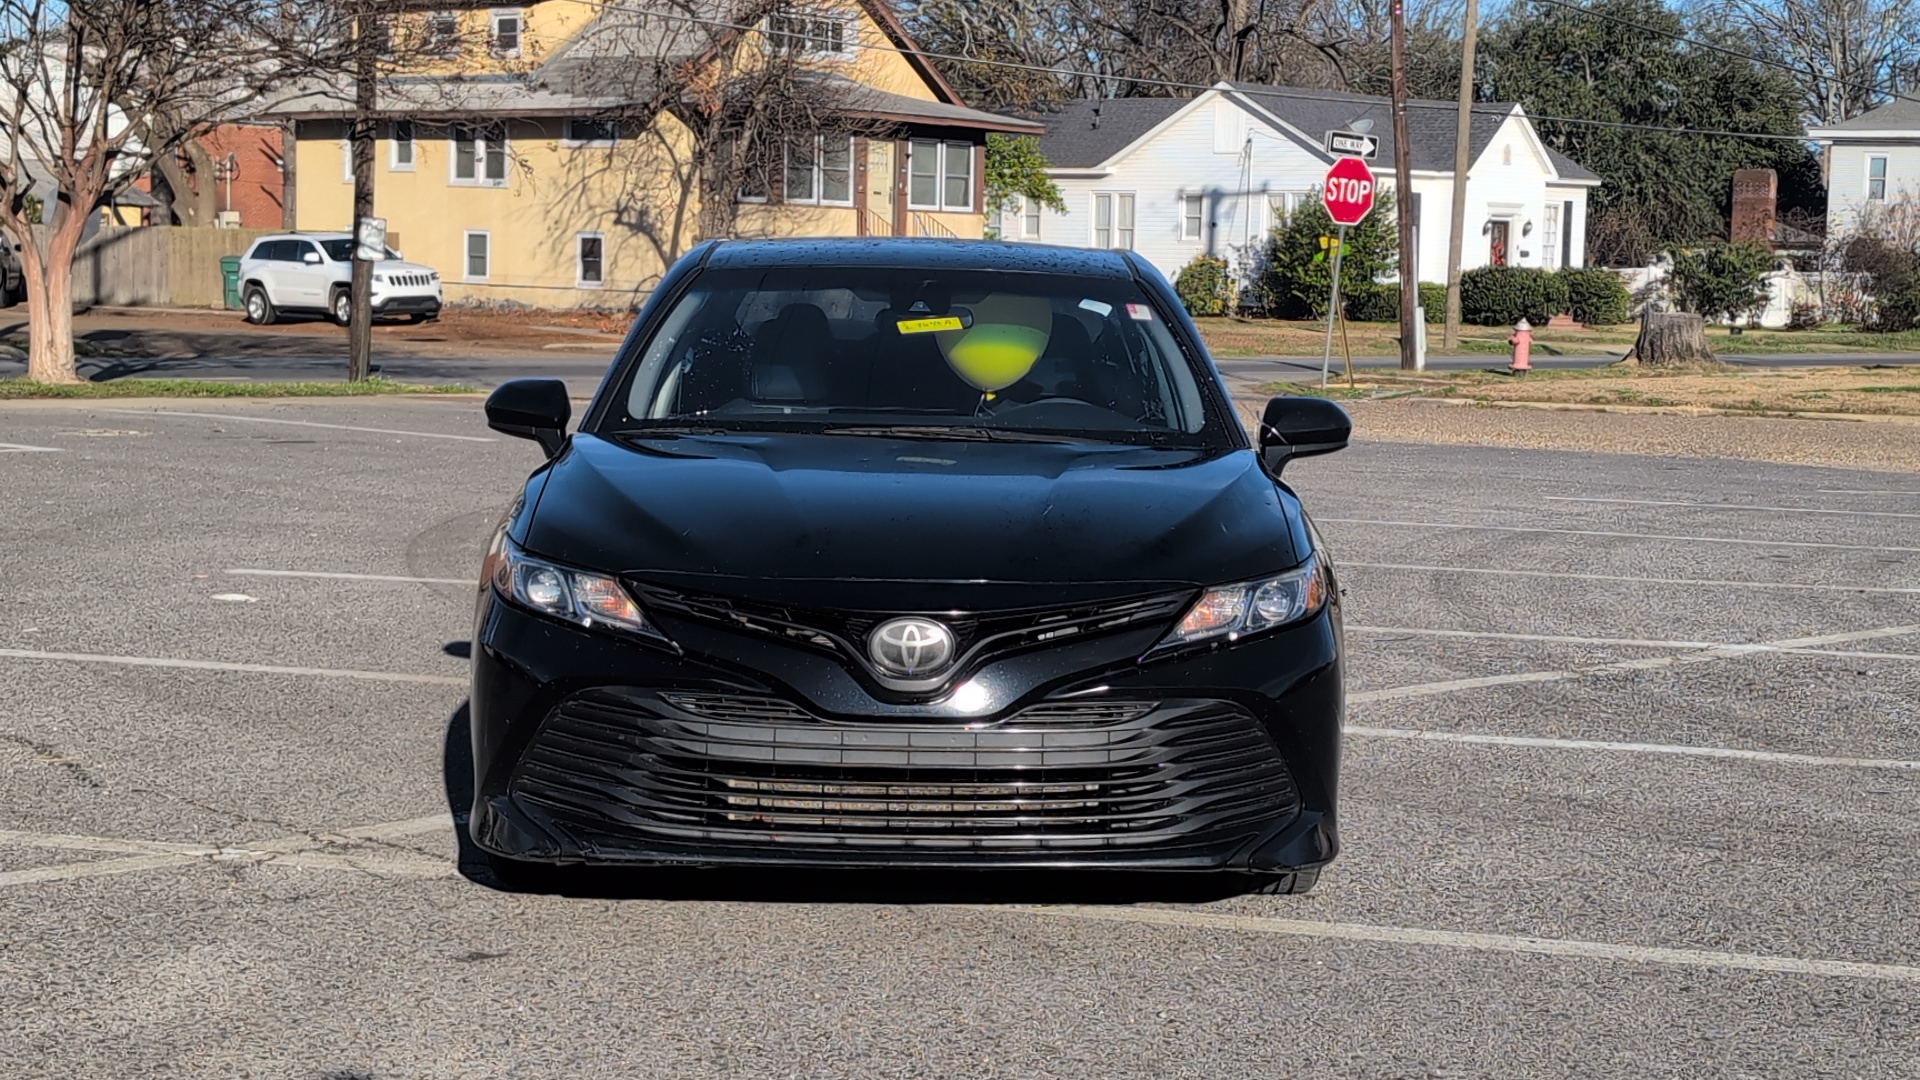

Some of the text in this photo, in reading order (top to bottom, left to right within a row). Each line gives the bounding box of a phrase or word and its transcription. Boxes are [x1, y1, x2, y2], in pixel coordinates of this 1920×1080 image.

[1335, 138, 1363, 149] ONE WAY
[1326, 176, 1370, 205] STOP
